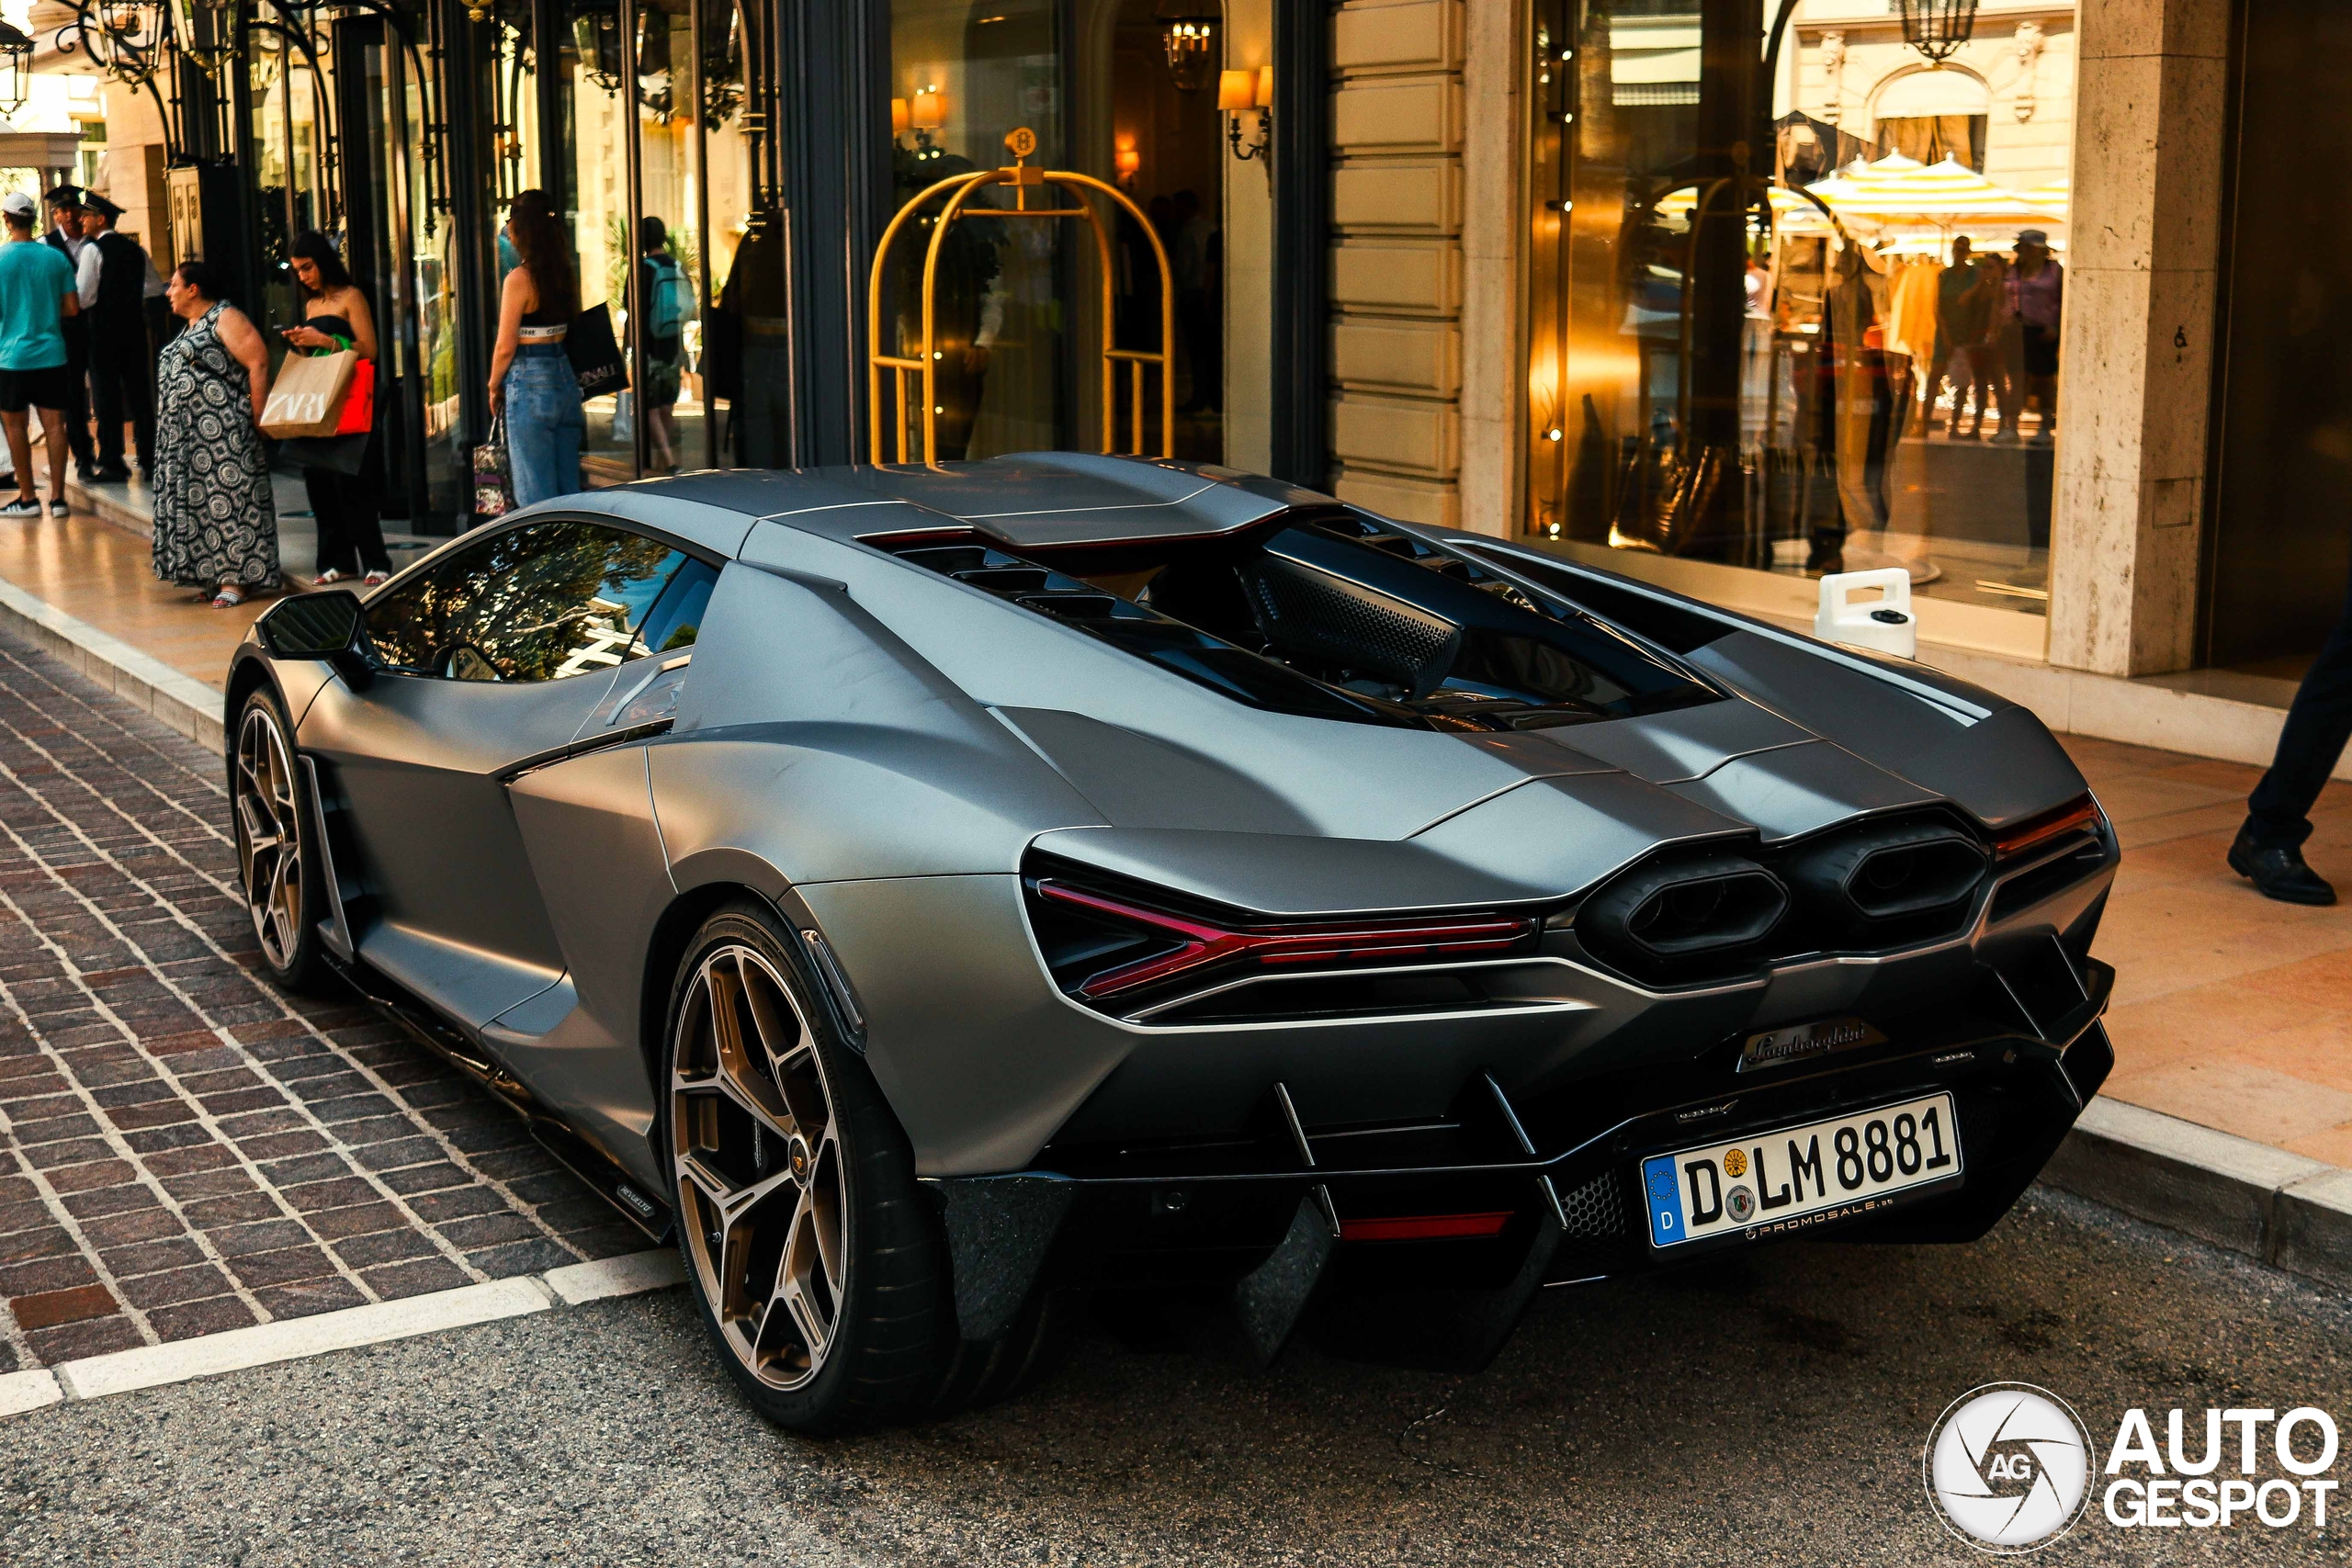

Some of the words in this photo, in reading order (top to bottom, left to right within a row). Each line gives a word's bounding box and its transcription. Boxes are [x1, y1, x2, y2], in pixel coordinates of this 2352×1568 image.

[1747, 1022, 1865, 1065] Lamborghini
[1683, 1158, 1724, 1226] D
[1752, 1134, 1826, 1212] LM
[1834, 1106, 1951, 1191] 8881
[620, 1186, 651, 1212] REVUELTO
[1660, 1211, 1674, 1230] D
